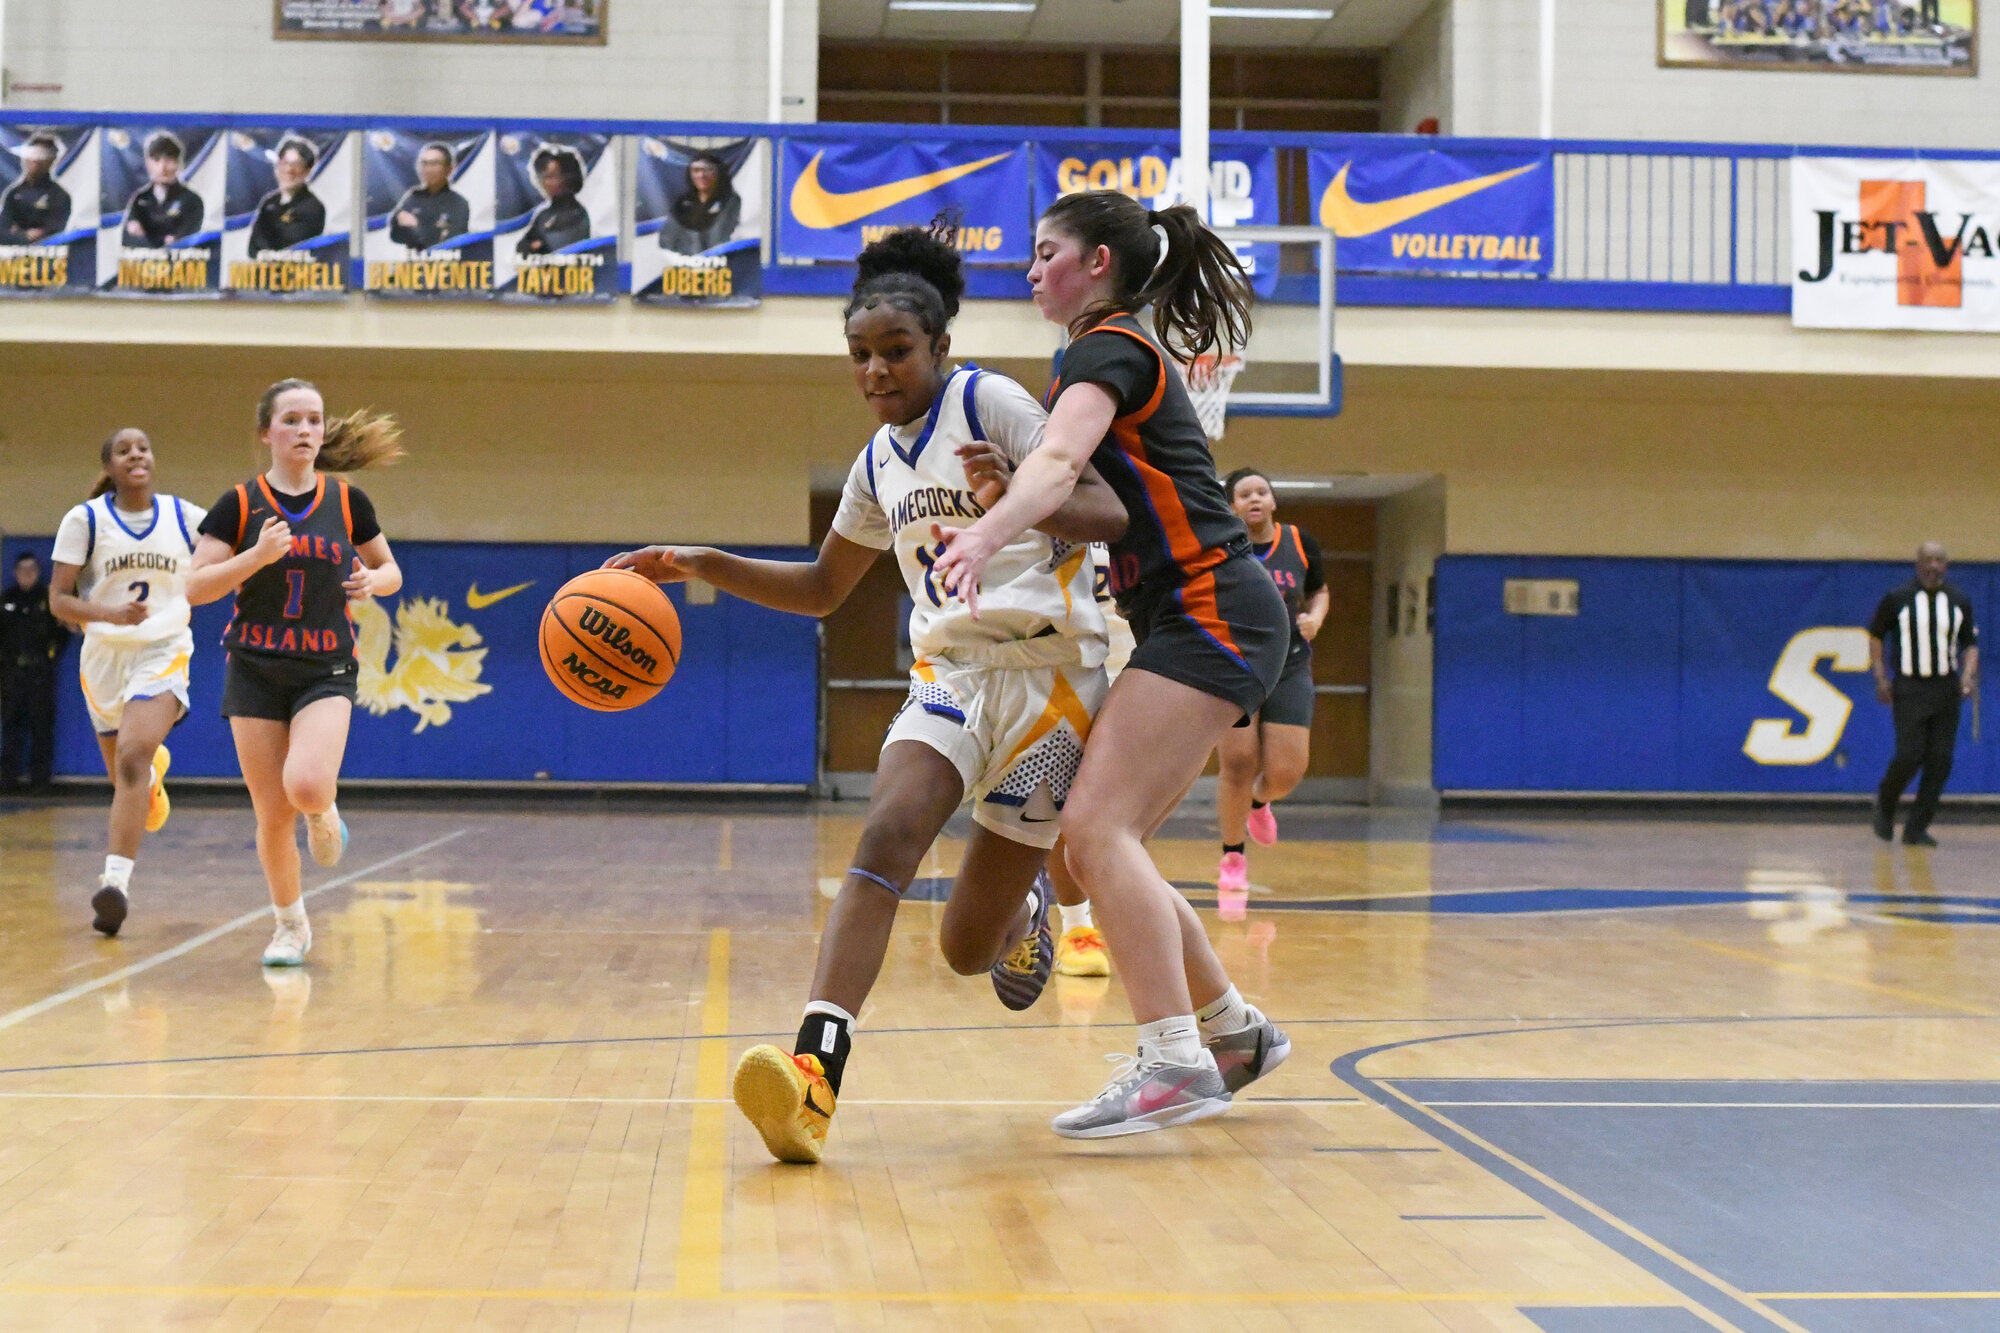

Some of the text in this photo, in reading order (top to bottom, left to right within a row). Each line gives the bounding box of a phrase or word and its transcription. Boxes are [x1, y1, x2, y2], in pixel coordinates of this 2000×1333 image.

[1057, 156, 1167, 198] GOLD
[1391, 233, 1542, 261] VOLLEYBALL
[1798, 210, 2000, 282] JET-VA
[117, 259, 207, 289] INGRAM
[369, 261, 492, 290] BENEVENTE
[516, 266, 594, 295] TAYLOR
[662, 267, 732, 296] OBERG
[889, 487, 986, 535] AMECOCKS
[288, 534, 342, 565] MES
[283, 569, 305, 619] 1
[240, 623, 338, 652] ISLAND
[579, 605, 658, 675] Wilson
[562, 652, 628, 699] NCAA
[1743, 626, 1872, 765] S
